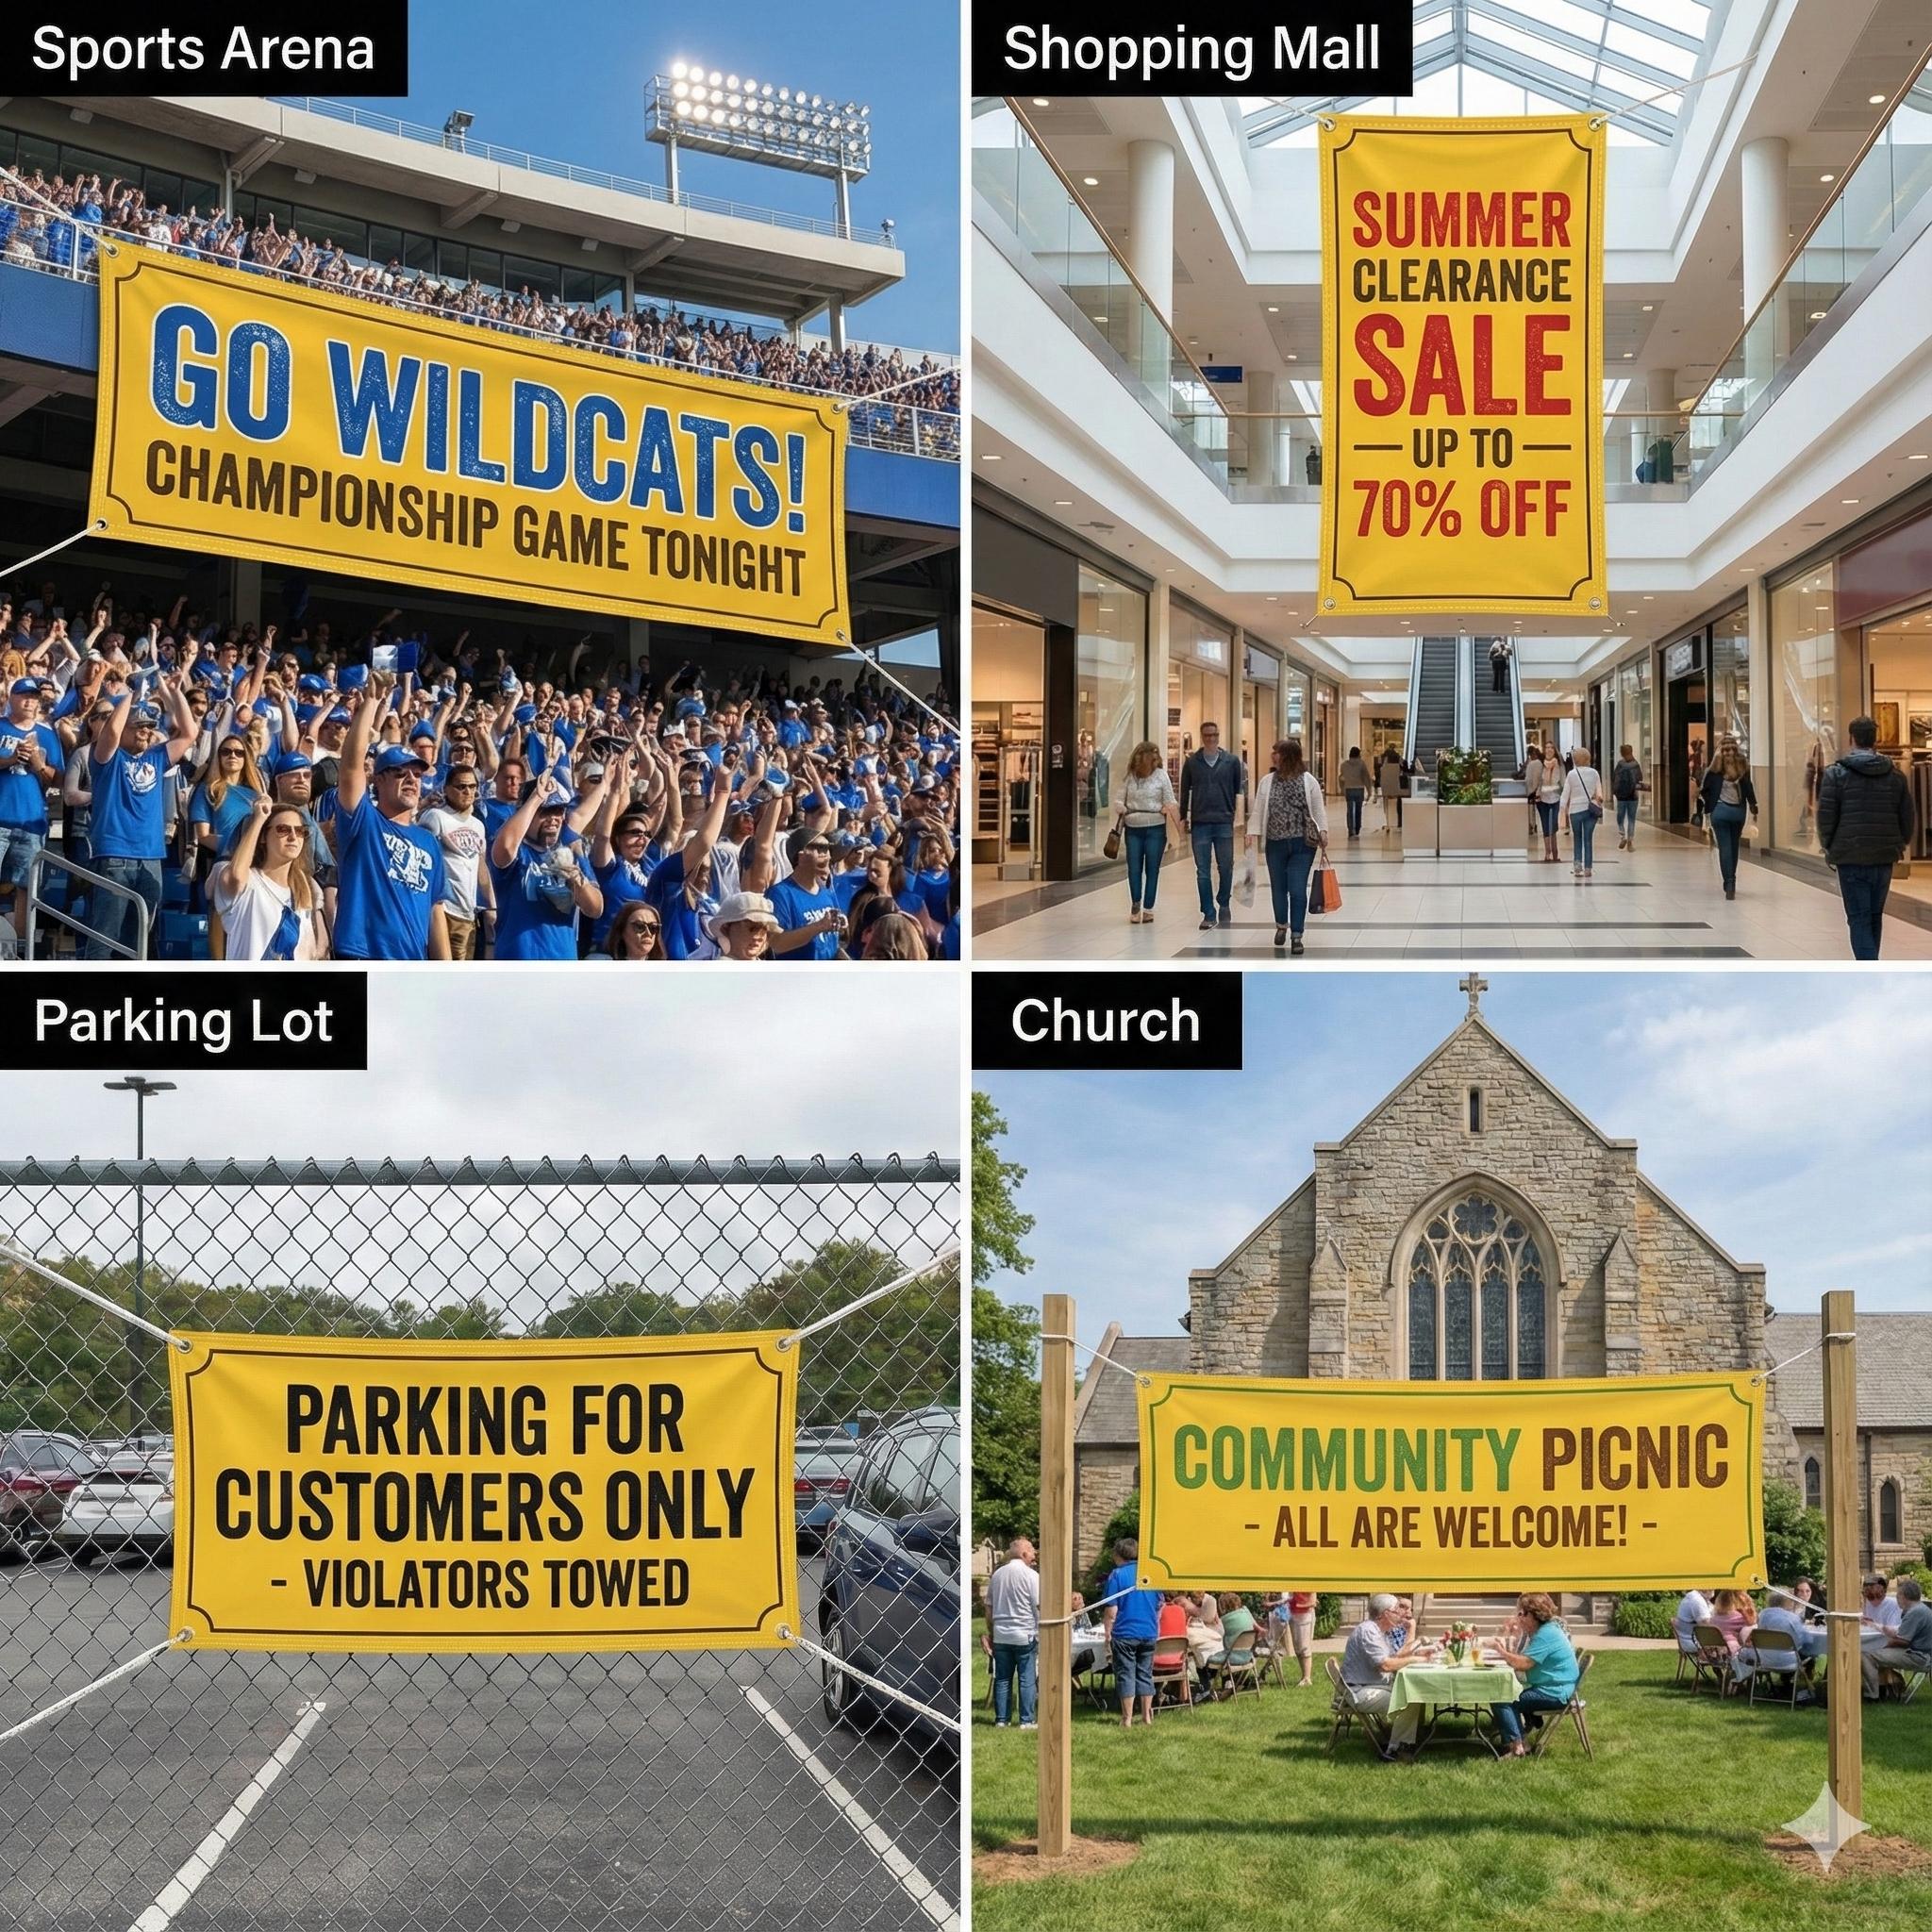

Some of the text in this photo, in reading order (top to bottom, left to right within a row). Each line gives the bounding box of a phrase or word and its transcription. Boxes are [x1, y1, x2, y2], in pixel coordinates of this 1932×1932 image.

[1352, 191, 1573, 250] SUMMER
[1353, 258, 1573, 305] CLEARANCE
[1353, 312, 1573, 418] SALE
[151, 304, 808, 536] GO WILDCATS!
[1412, 427, 1513, 470] UP TO
[144, 439, 807, 597] CHAMPIONSHIP GAME TONIGHT
[1353, 478, 1573, 539] 70% OFF
[286, 1382, 686, 1457] PARKING FOR
[1174, 1422, 1730, 1494] COMMUNITY PICNIC
[215, 1466, 757, 1543] CUSTOMERS ONLY
[1273, 1505, 1340, 1549] ALL
[1350, 1505, 1422, 1550] ARE
[1432, 1503, 1629, 1550] WELCOME!
[303, 1557, 531, 1609] VIOLATORS
[541, 1557, 691, 1609] TOWED
